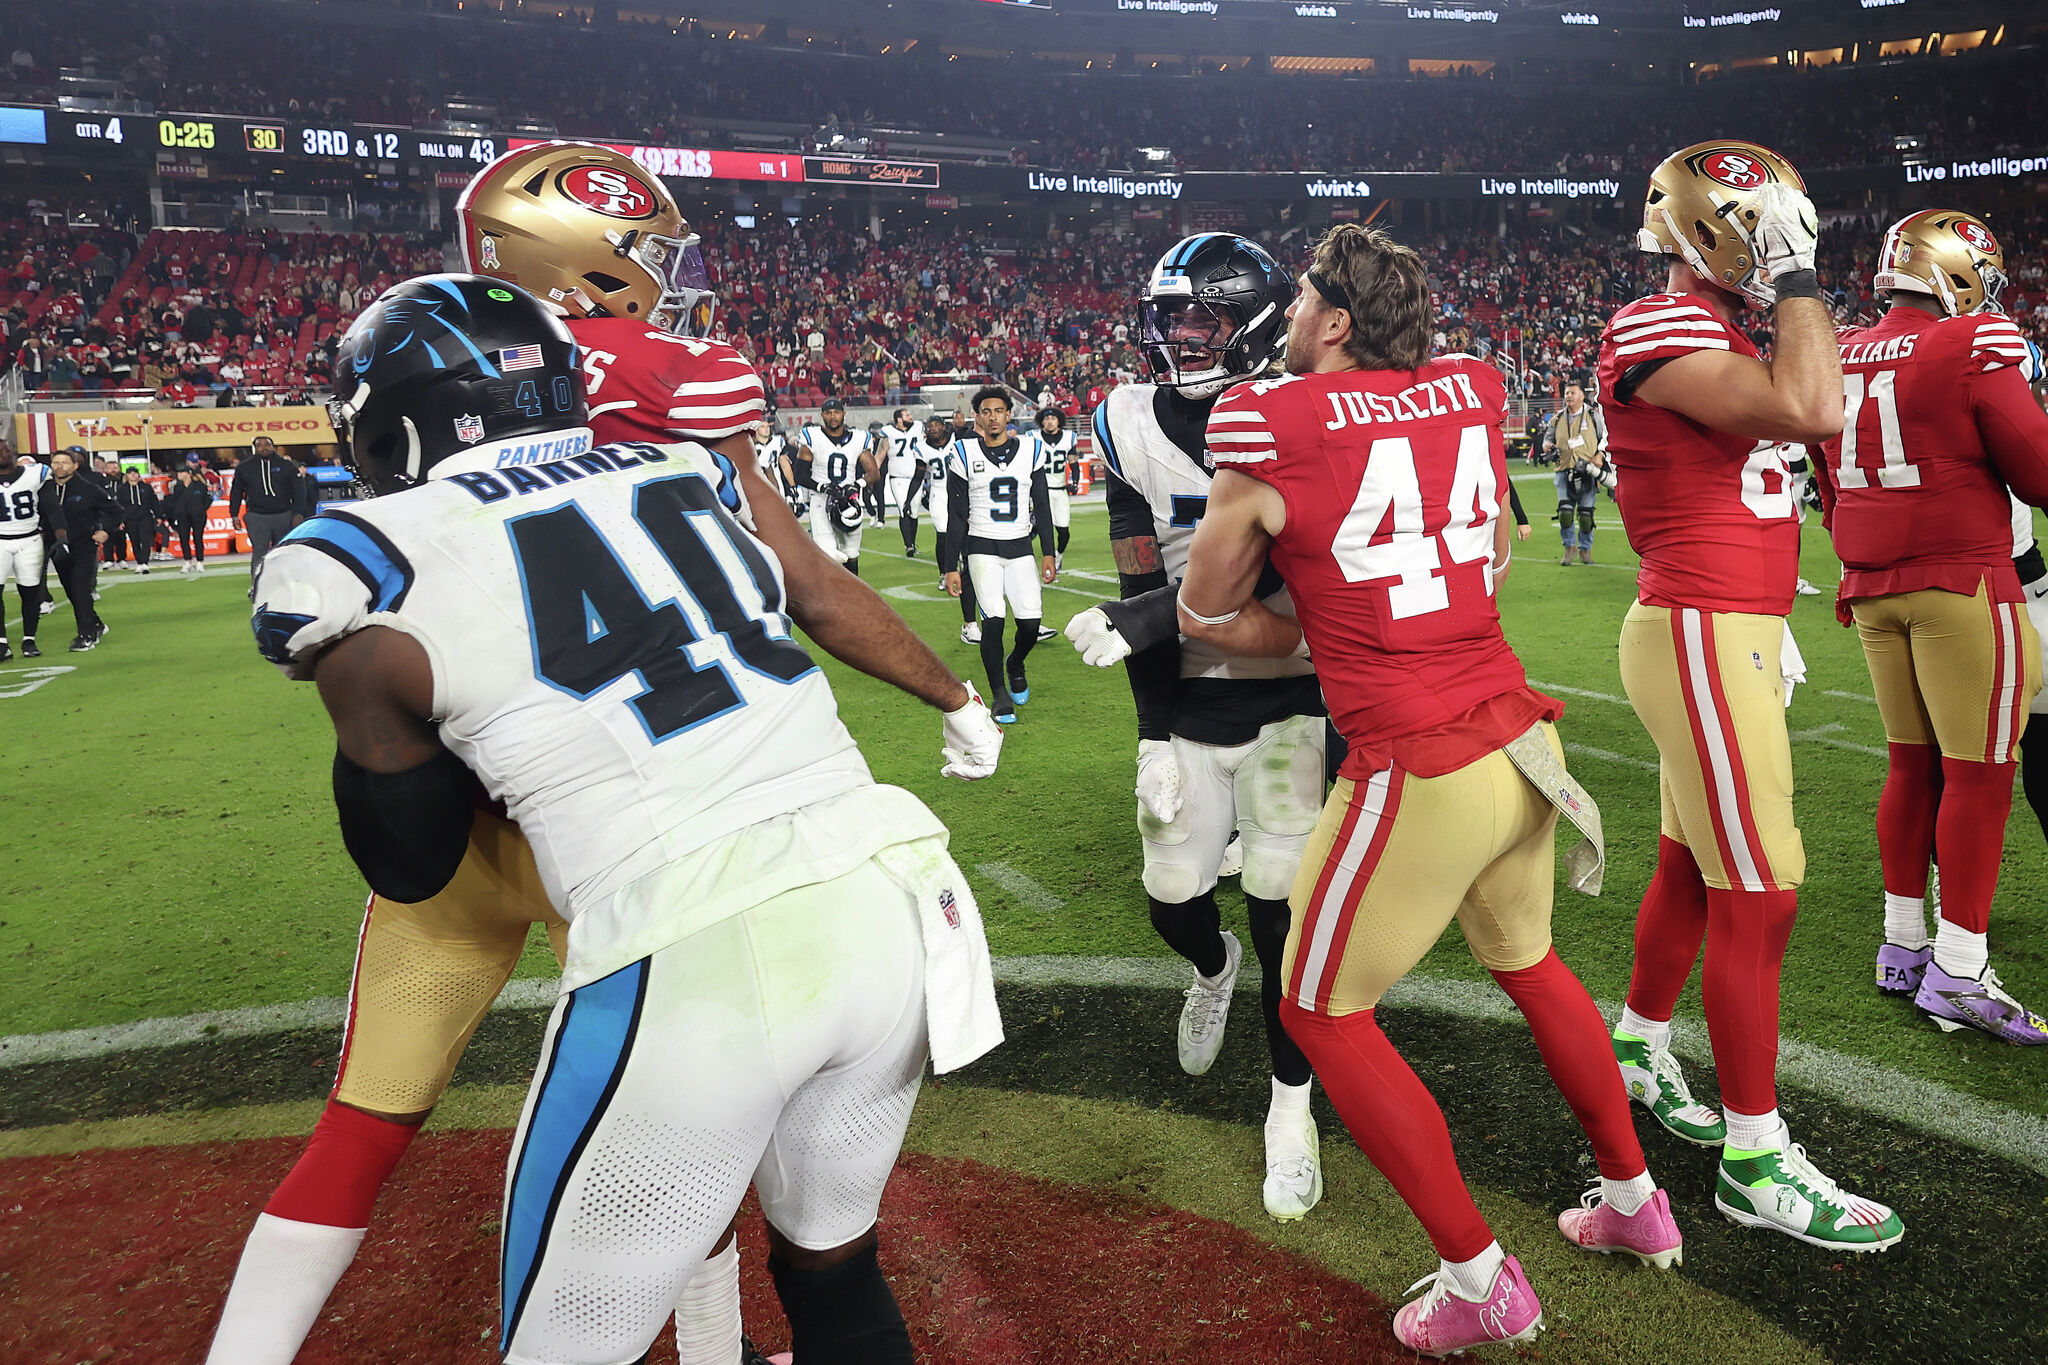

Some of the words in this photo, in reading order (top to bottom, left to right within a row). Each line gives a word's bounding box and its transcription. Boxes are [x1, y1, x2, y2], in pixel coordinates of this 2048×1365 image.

[1117, 0, 1143, 10] Live
[1146, 0, 1218, 14] Intelligently
[1407, 7, 1431, 19] Live
[1433, 8, 1499, 23] Intelligently
[1683, 16, 1706, 28] Live
[1710, 8, 1781, 27] Intelligently
[76, 122, 101, 138] QTR
[105, 117, 123, 144] 4
[159, 120, 216, 149] 0:25
[252, 129, 277, 150] 30
[302, 128, 349, 156] 3RD
[355, 139, 369, 158] &
[373, 133, 400, 159] 12
[419, 142, 446, 158] BALL
[447, 144, 463, 159] ON
[468, 138, 495, 164] 43
[629, 146, 713, 178] 49ERS
[759, 161, 776, 175] TOL
[779, 160, 788, 178] 1
[822, 161, 851, 175] HOME
[869, 163, 924, 183] Faithful
[1906, 165, 1947, 183] Live
[1028, 172, 1067, 192] Live
[1072, 175, 1183, 199] Intelligently
[1481, 178, 1517, 195] Live
[1520, 178, 1620, 198] Intelligently
[1837, 333, 1920, 365] LLIAMS
[515, 375, 574, 417] 40
[1325, 372, 1483, 431] JUSZCZYK
[78, 423, 144, 438] SAN
[153, 419, 319, 436] FRANCISCO
[460, 426, 482, 441] NFL
[1835, 369, 1922, 489] 71
[494, 434, 588, 468] PANTHERS
[440, 441, 669, 505] BARNES
[827, 452, 848, 484] 0
[989, 476, 1019, 523] 9
[1331, 424, 1501, 621] 44
[503, 471, 822, 747] 40
